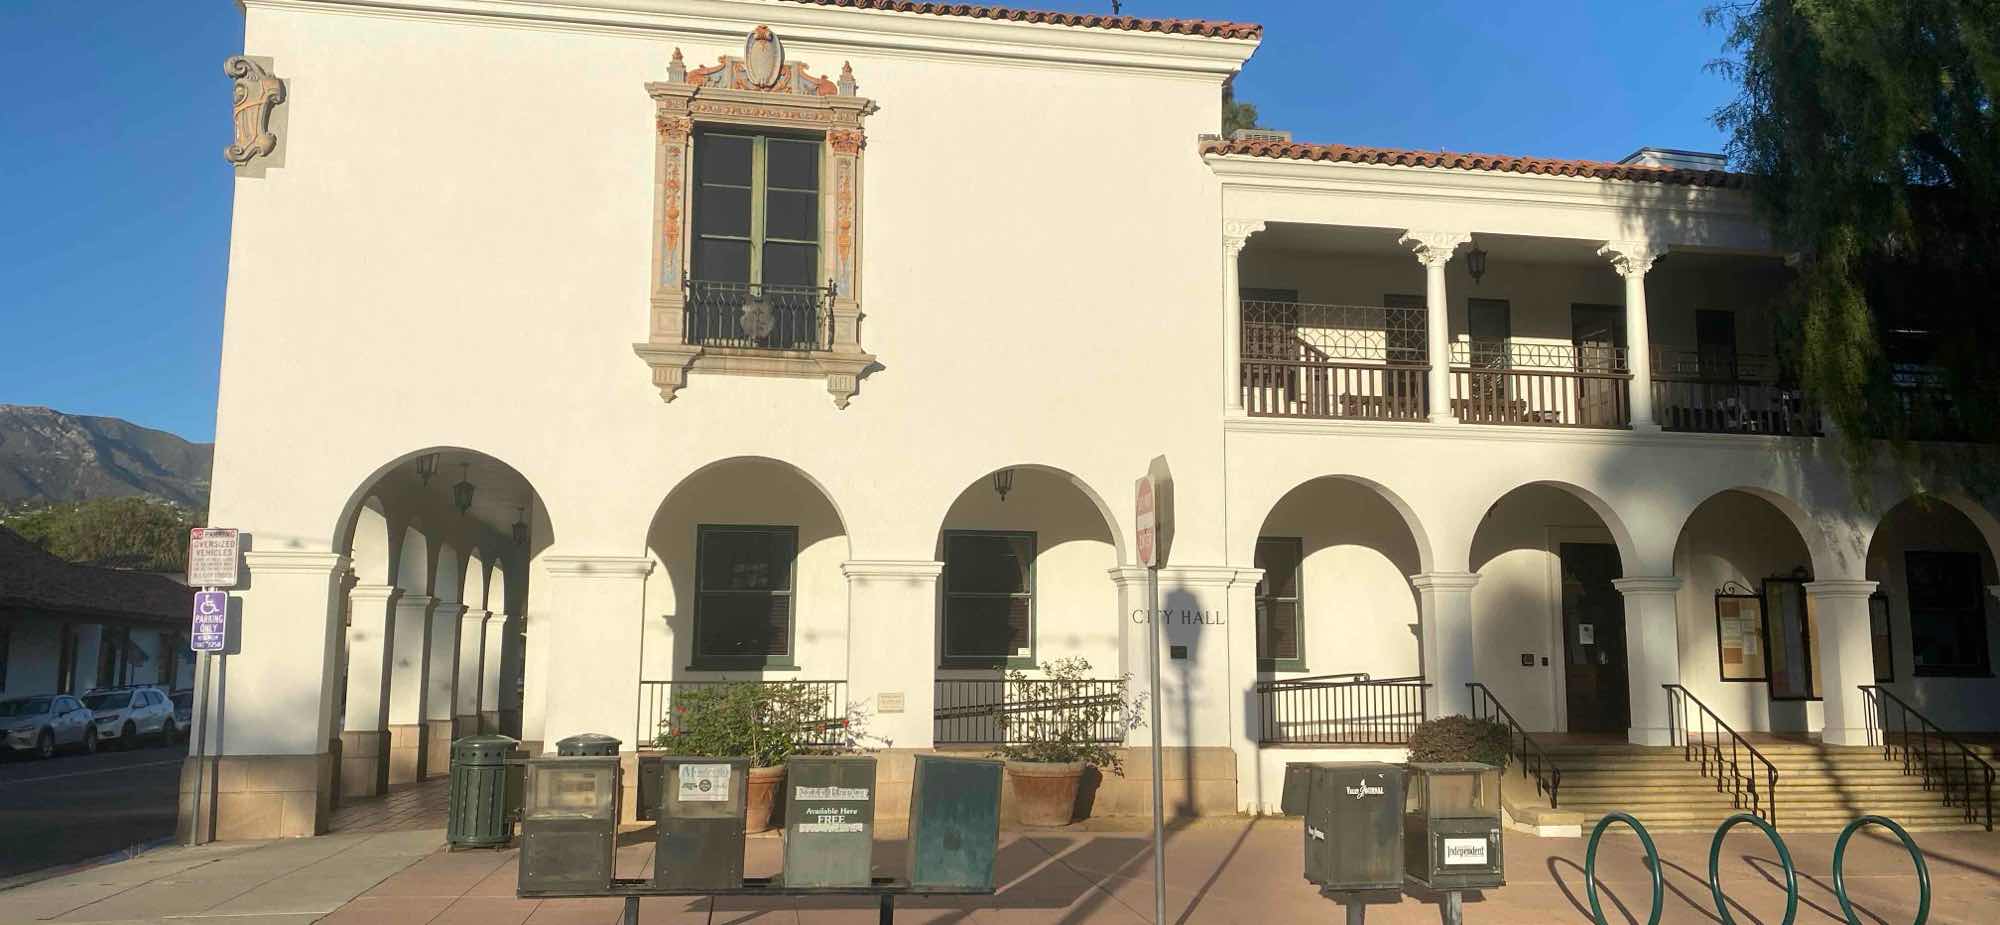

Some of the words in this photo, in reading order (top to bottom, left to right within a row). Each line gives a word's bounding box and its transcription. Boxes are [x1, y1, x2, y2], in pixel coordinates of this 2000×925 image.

[196, 548, 233, 557] VEHICLES
[195, 614, 224, 624] PARKING
[1132, 609, 1174, 625] CIY
[1181, 609, 1225, 625] HALL
[199, 623, 218, 633] ONLY
[806, 807, 839, 815] Available
[840, 807, 858, 815] Here
[817, 815, 846, 824] FREE
[1447, 845, 1484, 858] Independent
